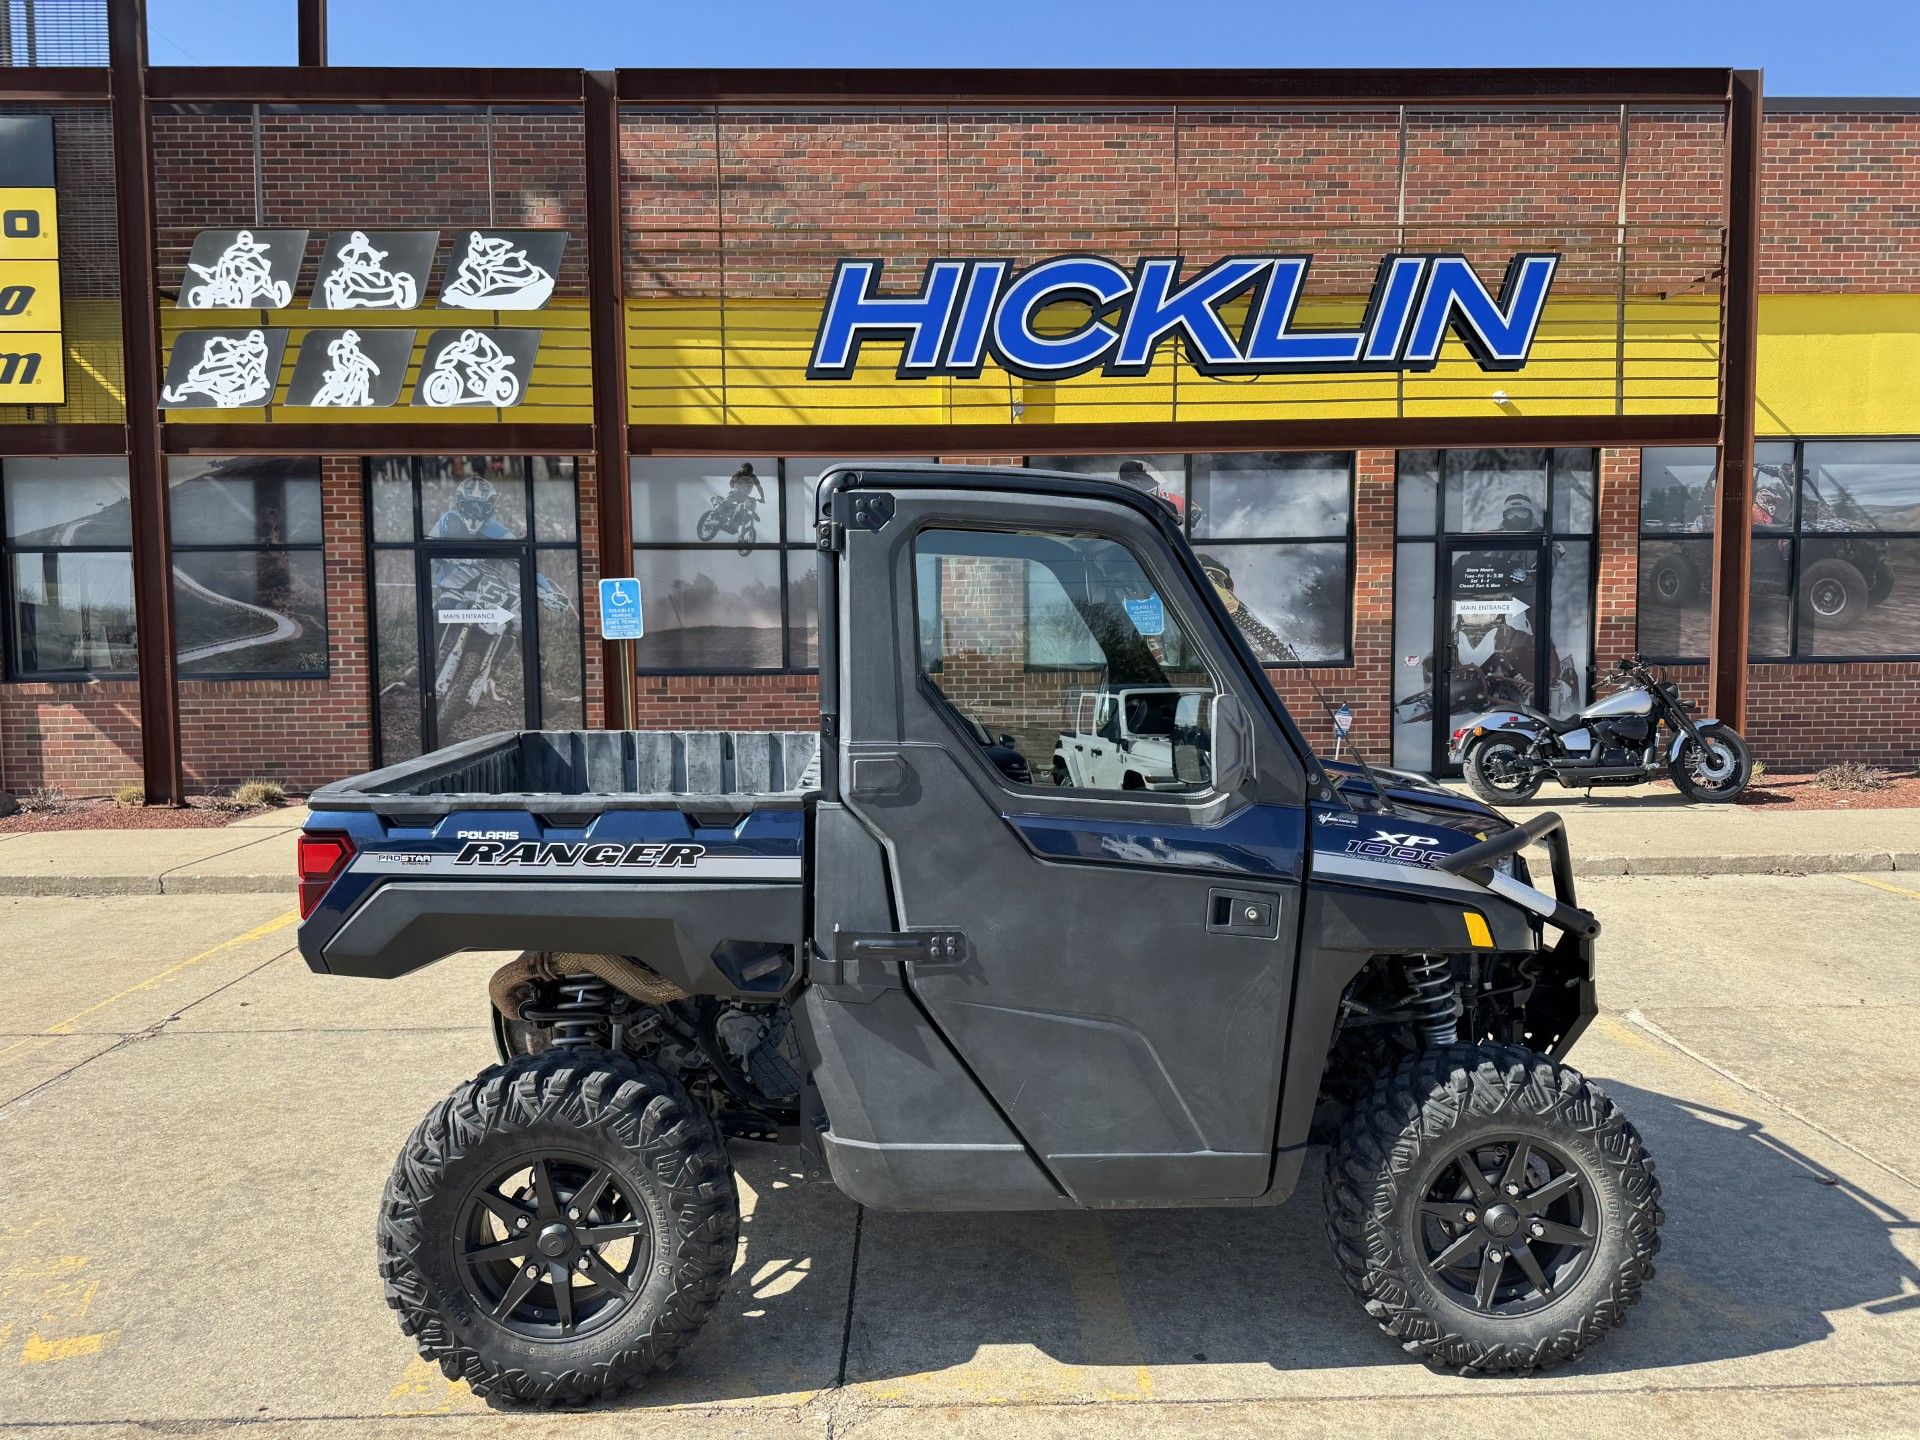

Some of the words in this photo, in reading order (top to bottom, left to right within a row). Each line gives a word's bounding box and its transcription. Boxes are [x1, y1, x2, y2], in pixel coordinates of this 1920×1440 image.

[806, 252, 1560, 380] HICKLIN
[457, 830, 520, 840] POLARIS
[1367, 830, 1440, 846] XP
[377, 854, 432, 863] PROSTAR
[452, 842, 706, 868] RANGER
